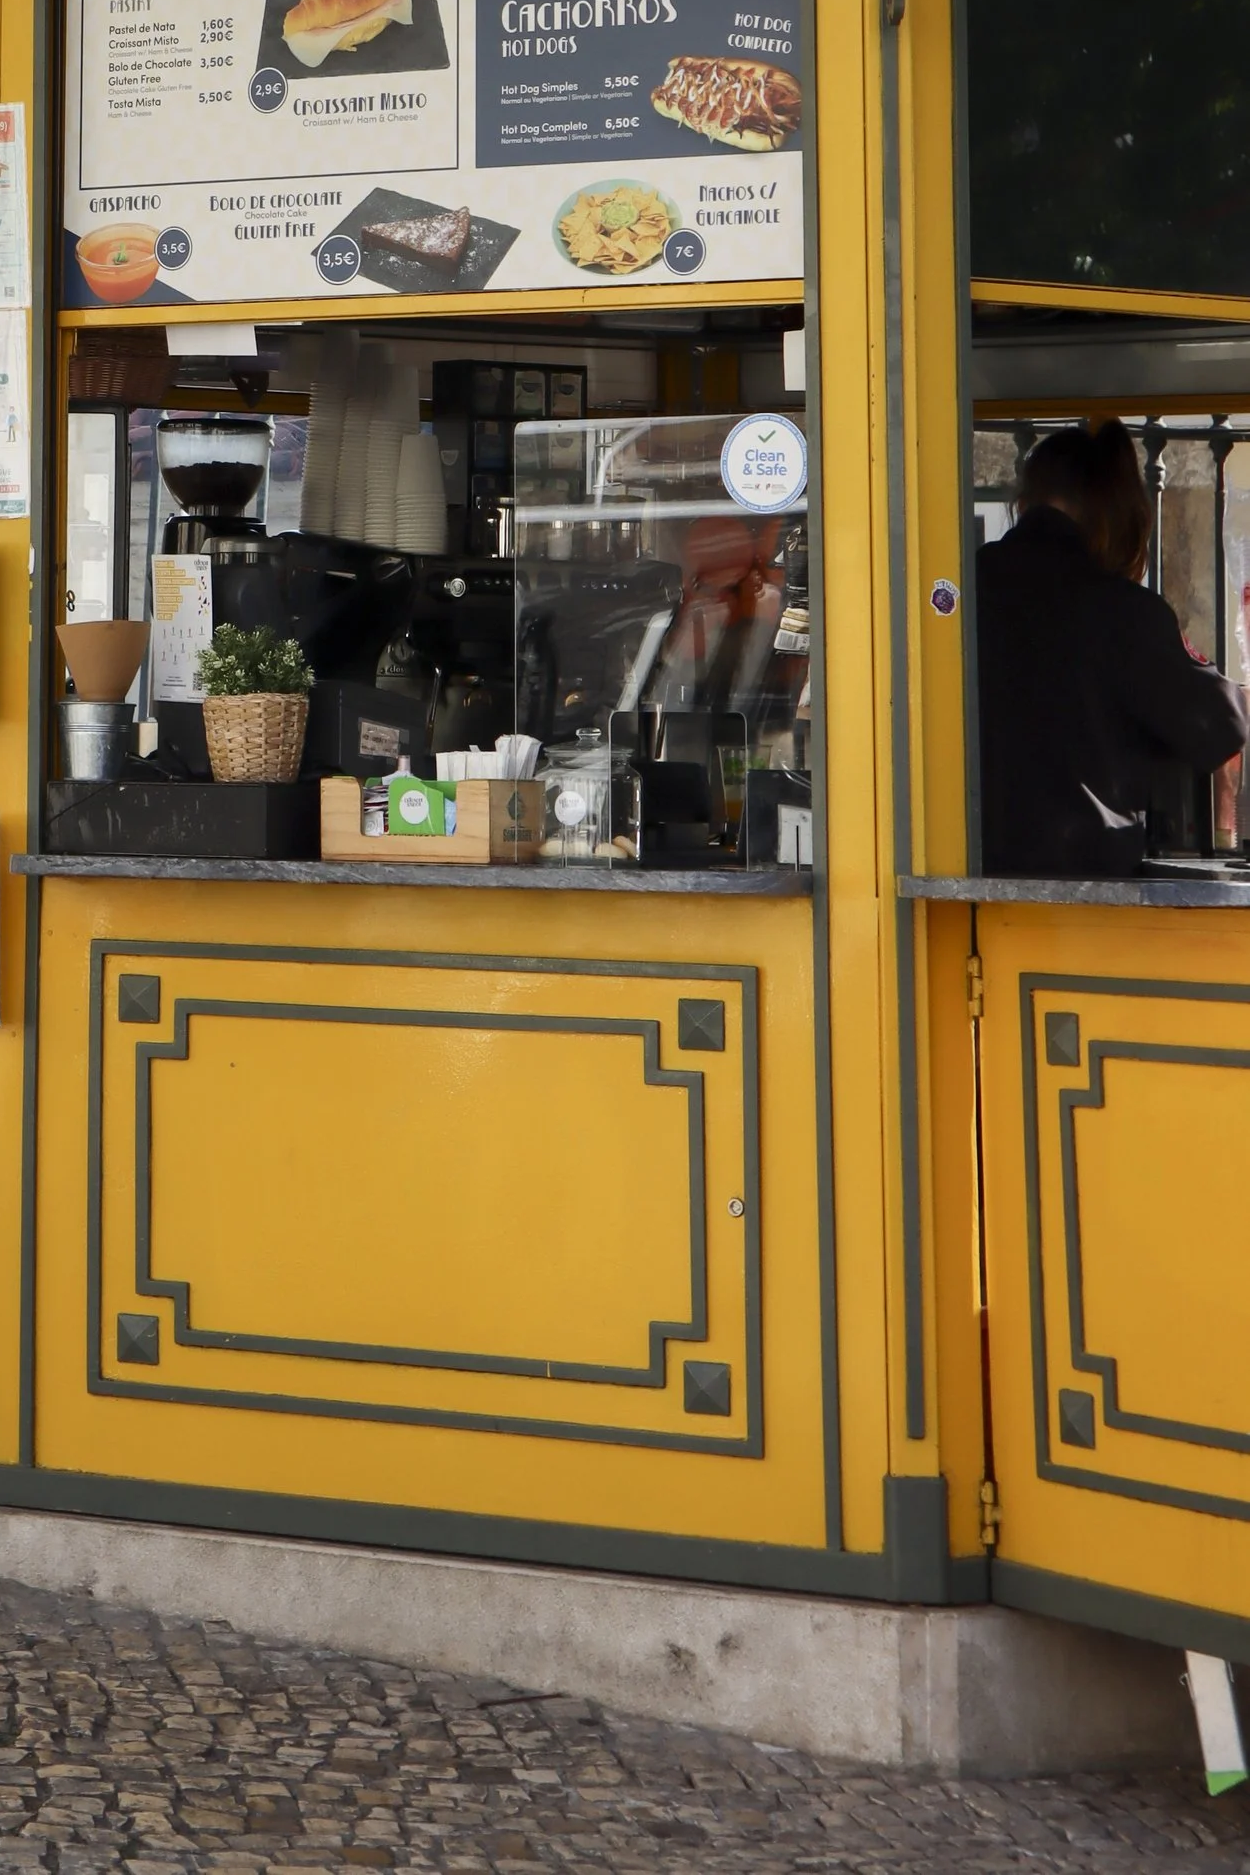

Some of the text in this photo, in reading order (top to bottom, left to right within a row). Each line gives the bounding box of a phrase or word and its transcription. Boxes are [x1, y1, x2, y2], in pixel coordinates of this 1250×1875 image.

[109, 18, 233, 35] Pastel de Nata 1,60€
[734, 13, 792, 33] HOT DOG
[109, 31, 233, 49] Croissant Misto 2,90€
[502, 36, 577, 57] HOT DOGS
[727, 34, 792, 54] COMPLETO
[109, 57, 233, 72] Bolo de Chocolate 3,50€
[109, 75, 161, 86] Gluten Free
[501, 75, 639, 95] Hot Dog Simples 5,50€
[255, 84, 282, 97] 2,9€
[109, 91, 232, 109] Tosta Mista 5,50€
[293, 93, 427, 115] CROISSANT MISTO
[302, 118, 341, 127] Croissant
[343, 117, 354, 125] w/
[357, 116, 377, 124] Ham
[387, 113, 418, 122] Cheese
[501, 117, 639, 135] Hot Dog Completo 6,50€
[89, 195, 162, 213] GASPACHO
[210, 191, 343, 211] BOLO DE CHOCOLATE
[245, 209, 308, 219] Chocolate Cake
[696, 208, 780, 226] GUACAMOLE
[235, 222, 315, 240] GLUTEN FREE
[162, 243, 186, 255] 3,5€
[675, 245, 694, 258] 7€
[323, 252, 354, 267] 3,5€
[745, 449, 785, 462] Clean
[743, 463, 788, 476] & Safe
